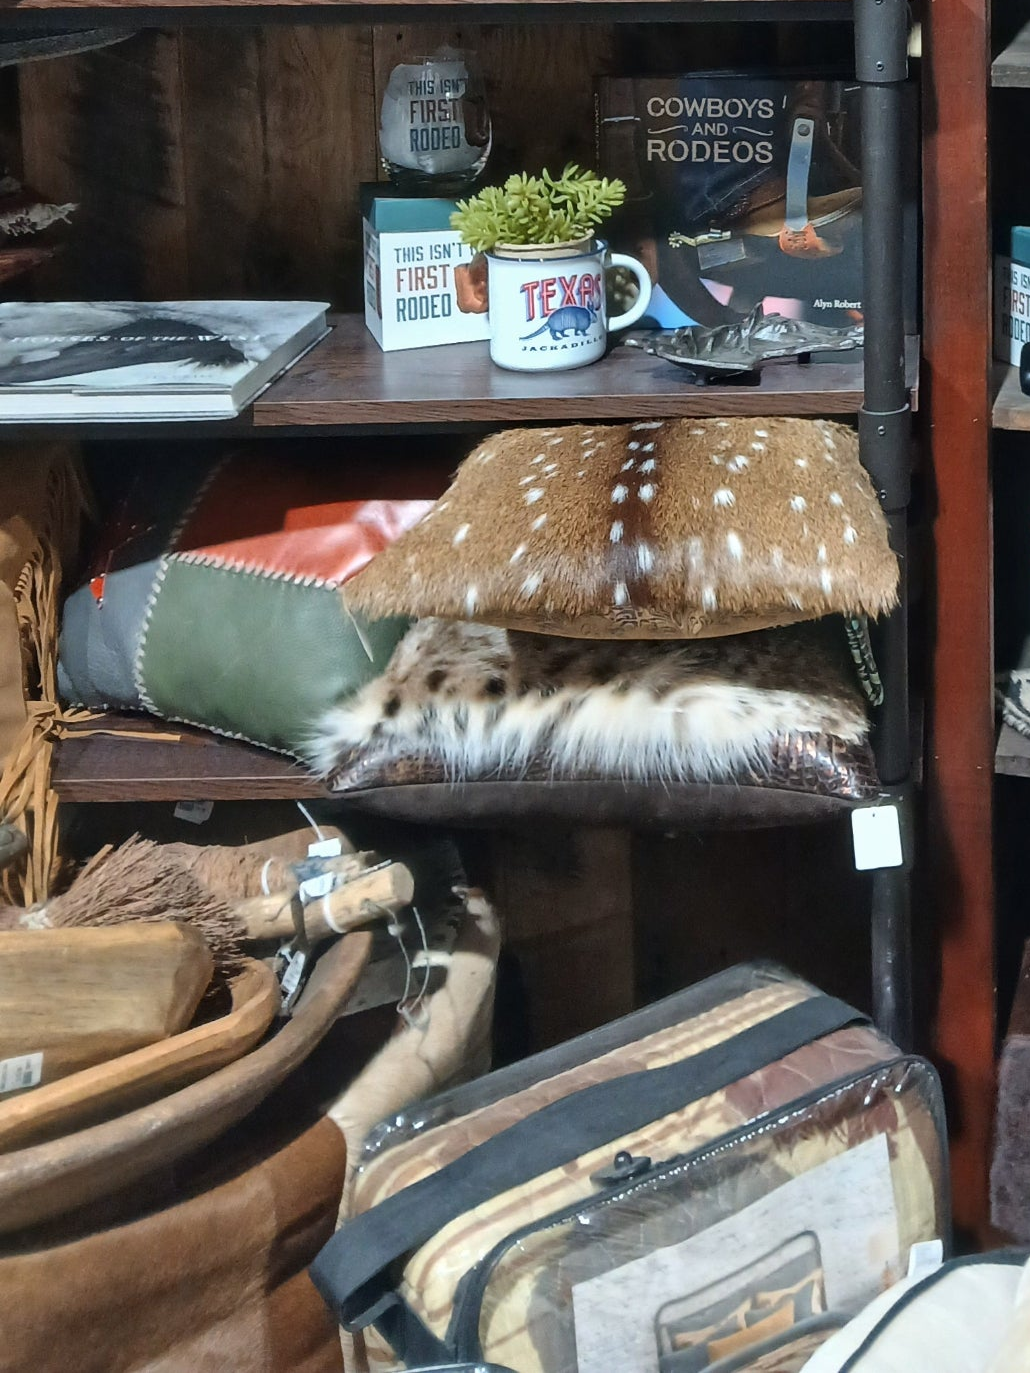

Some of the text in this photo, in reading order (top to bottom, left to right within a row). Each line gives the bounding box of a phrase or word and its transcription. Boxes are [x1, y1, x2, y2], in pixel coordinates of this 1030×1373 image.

[408, 79, 435, 95] THIS
[410, 98, 459, 123] FIRST
[647, 97, 774, 118] COWBOYS
[410, 126, 461, 152] RODEO
[691, 122, 728, 136] AND
[647, 139, 773, 163] RODEOS
[394, 246, 423, 263] THIS
[430, 242, 462, 260] ISN'T
[396, 264, 450, 293] FIRST
[396, 293, 451, 322] RODEO
